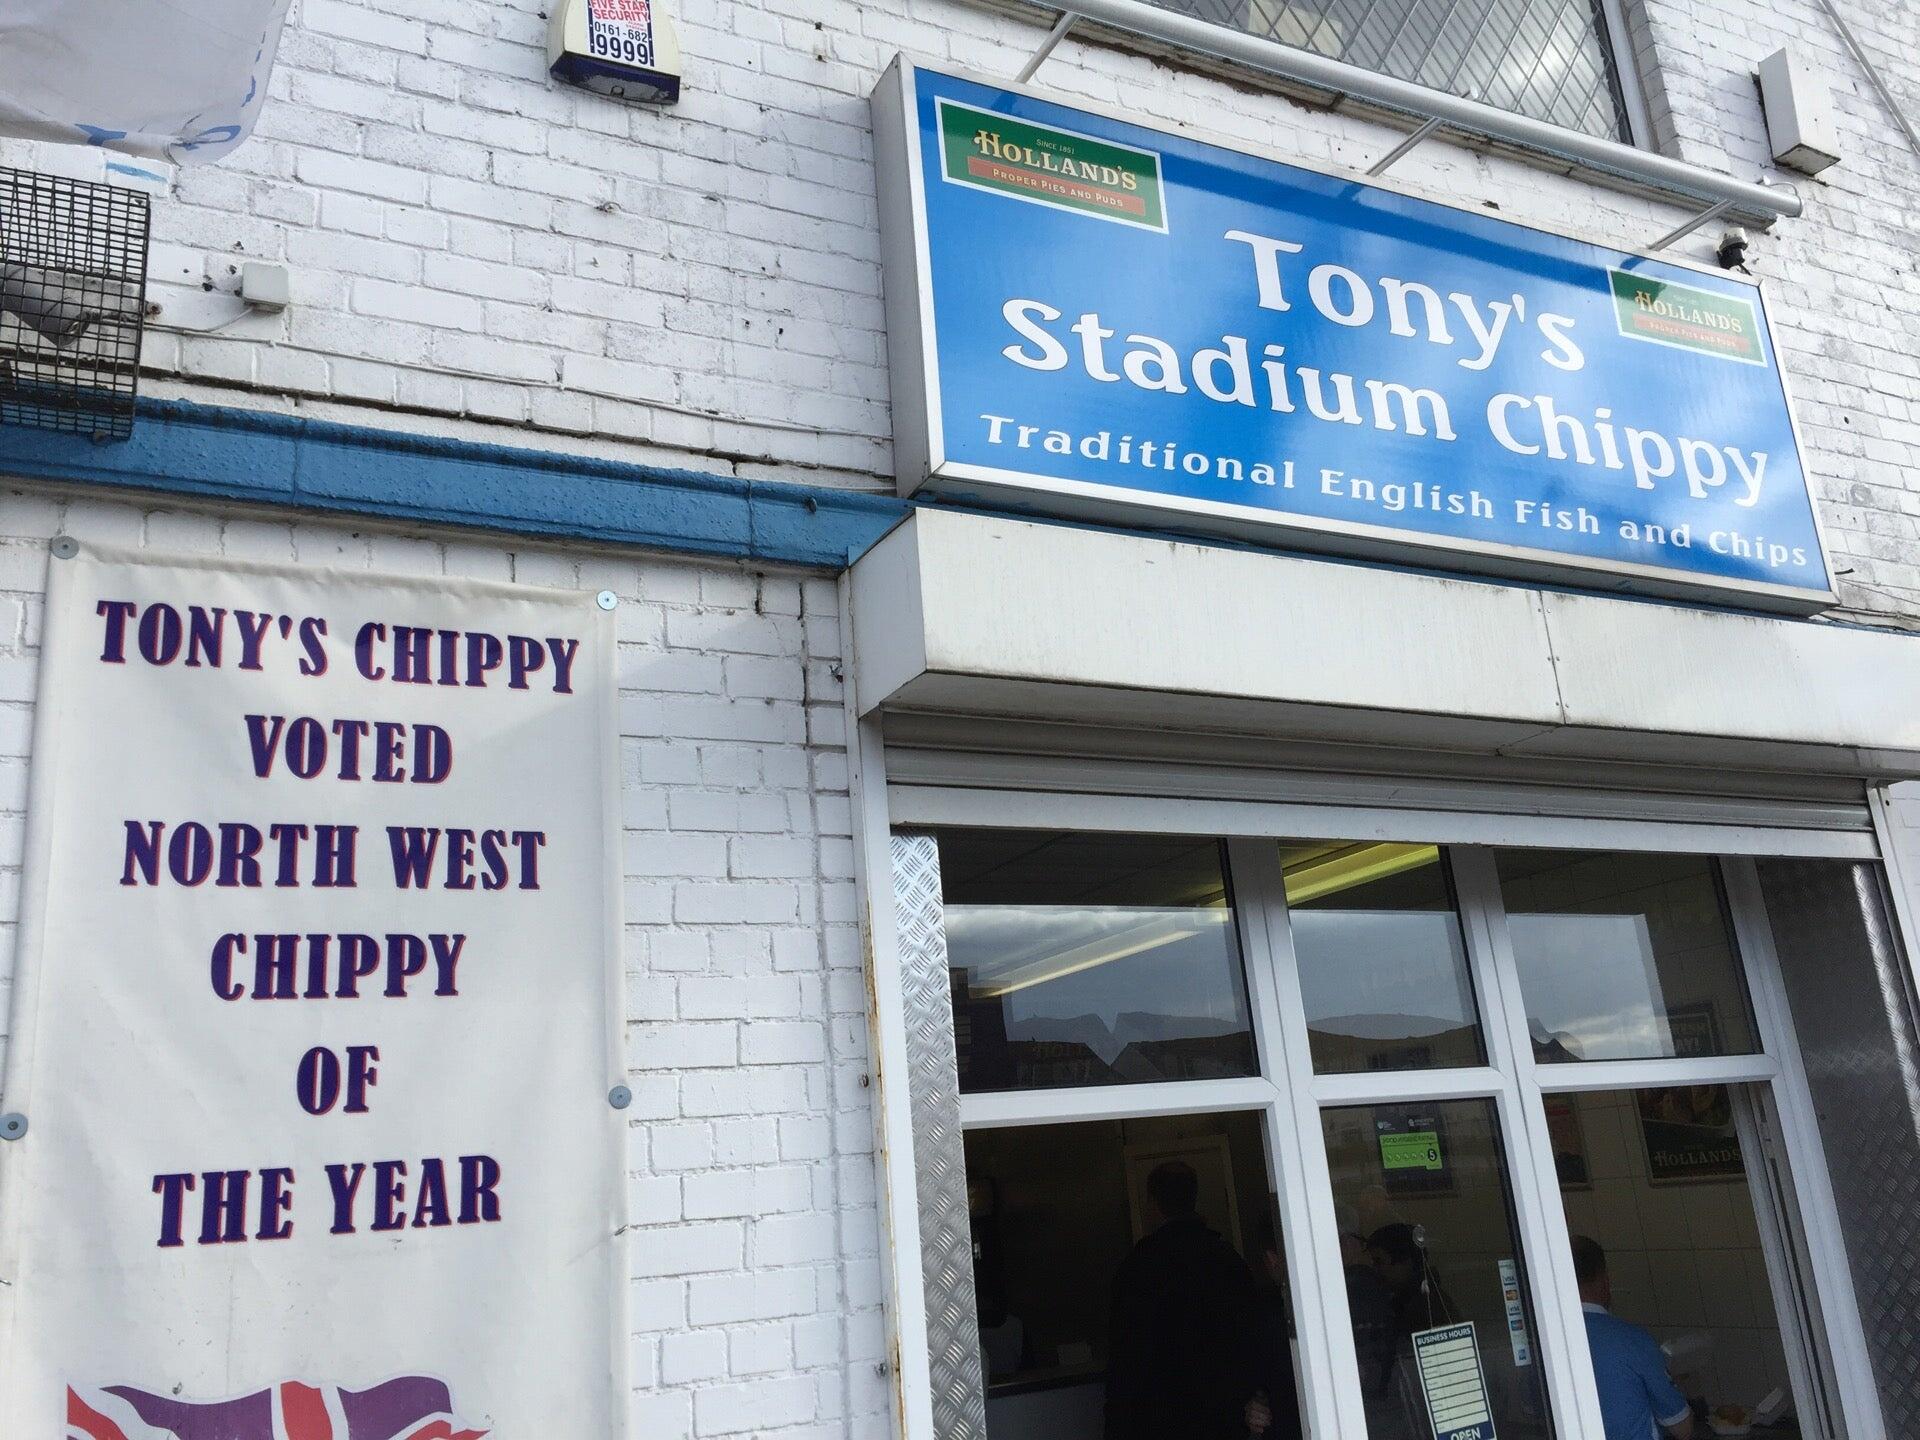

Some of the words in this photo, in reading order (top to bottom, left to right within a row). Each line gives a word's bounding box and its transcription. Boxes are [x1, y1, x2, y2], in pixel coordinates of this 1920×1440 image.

[591, 0, 616, 9] FIVE
[618, 0, 647, 11] STAR
[593, 9, 648, 22] SECURITY
[596, 34, 648, 65] 9999
[973, 129, 1137, 191] HOLLAND'S
[1036, 139, 1057, 151] SINCE
[993, 168, 1037, 186] PROPER
[1041, 180, 1066, 194] PIES
[1070, 189, 1091, 200] AND
[1096, 193, 1123, 207] PUDS
[1224, 230, 1585, 371] Tony's
[1635, 290, 1742, 333] HOLLAND'S
[1002, 298, 1457, 441] Stadium
[1487, 393, 1768, 507] Chippy
[980, 414, 1295, 489] Traditional
[1320, 469, 1494, 519] English
[1515, 500, 1600, 535] Fish
[1619, 519, 1691, 548] and
[1708, 531, 1807, 567] Chips
[96, 600, 328, 677] TONY'S
[355, 621, 580, 694] CHIPPY
[244, 714, 453, 784] VOTED
[120, 820, 359, 888] NORTH
[386, 826, 545, 890] WEST
[210, 933, 466, 1001] CHIPPY
[297, 1046, 380, 1115] OF
[152, 1167, 294, 1248] THE
[325, 1155, 501, 1234] YEAR
[1416, 1333, 1448, 1346] BUSINESS
[1448, 1327, 1471, 1339] HOURS
[1450, 1427, 1481, 1440] OPEN
